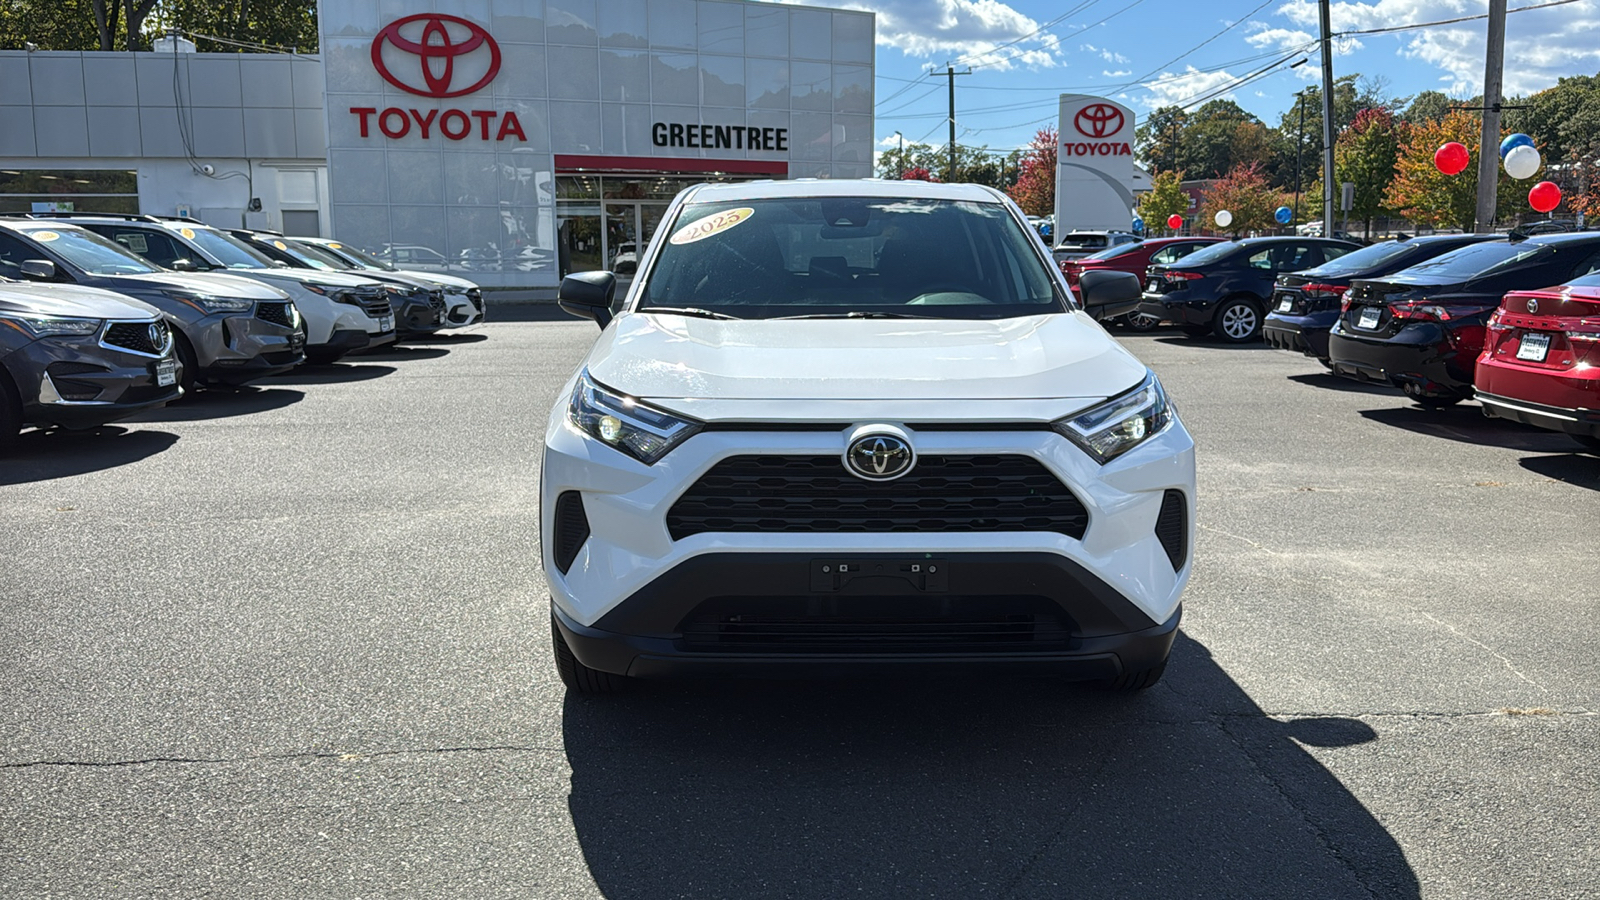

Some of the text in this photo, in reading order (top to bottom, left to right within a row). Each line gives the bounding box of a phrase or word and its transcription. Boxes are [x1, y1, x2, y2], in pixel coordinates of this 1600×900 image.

[350, 107, 527, 141] TOYOTA
[652, 122, 788, 151] GREENTREE
[1064, 142, 1132, 156] TOYOTA
[687, 211, 741, 240] 2025
